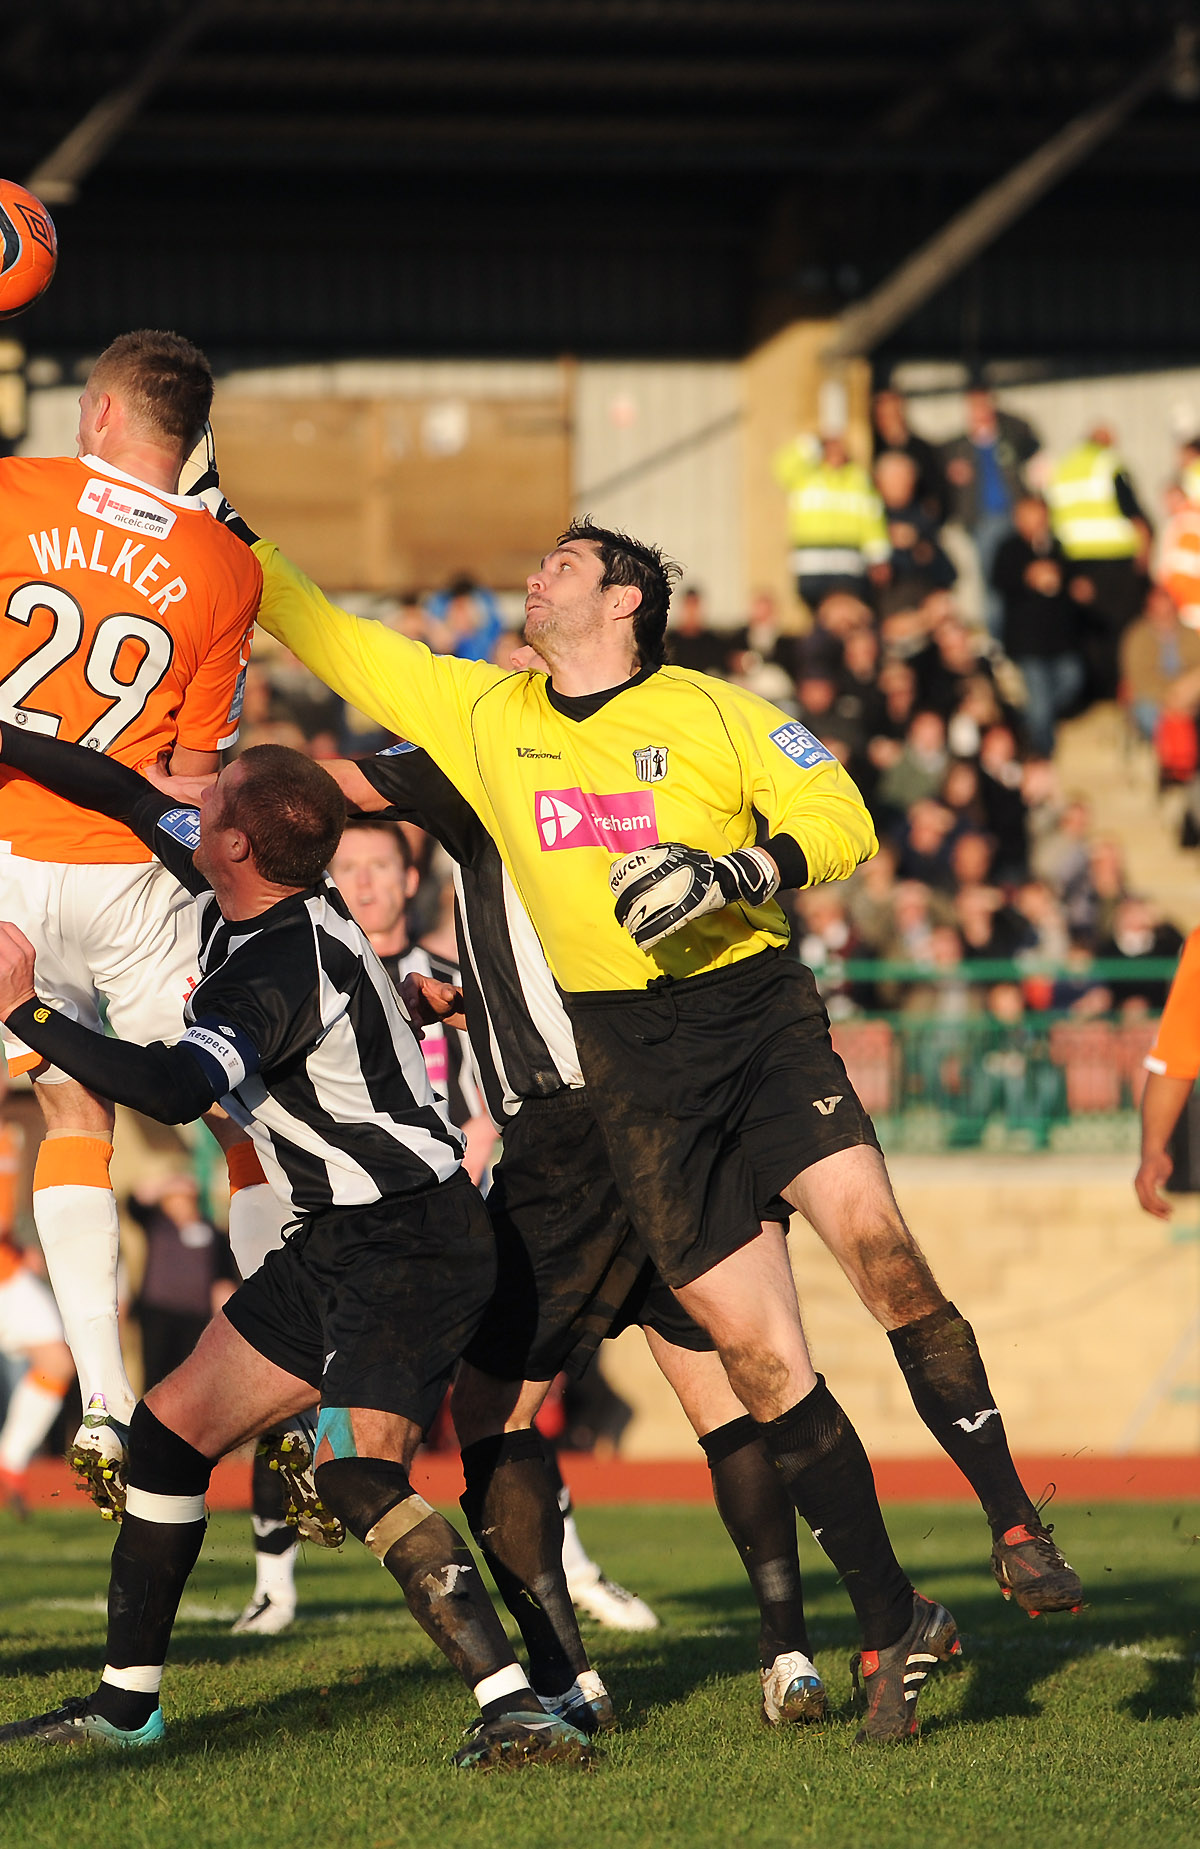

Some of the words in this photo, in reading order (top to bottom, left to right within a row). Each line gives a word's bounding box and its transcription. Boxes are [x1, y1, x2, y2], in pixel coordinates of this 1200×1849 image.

[114, 513, 164, 534] niceic.com
[28, 526, 188, 616] WALKER
[610, 855, 647, 892] reusch
[188, 1029, 230, 1057] Respect
